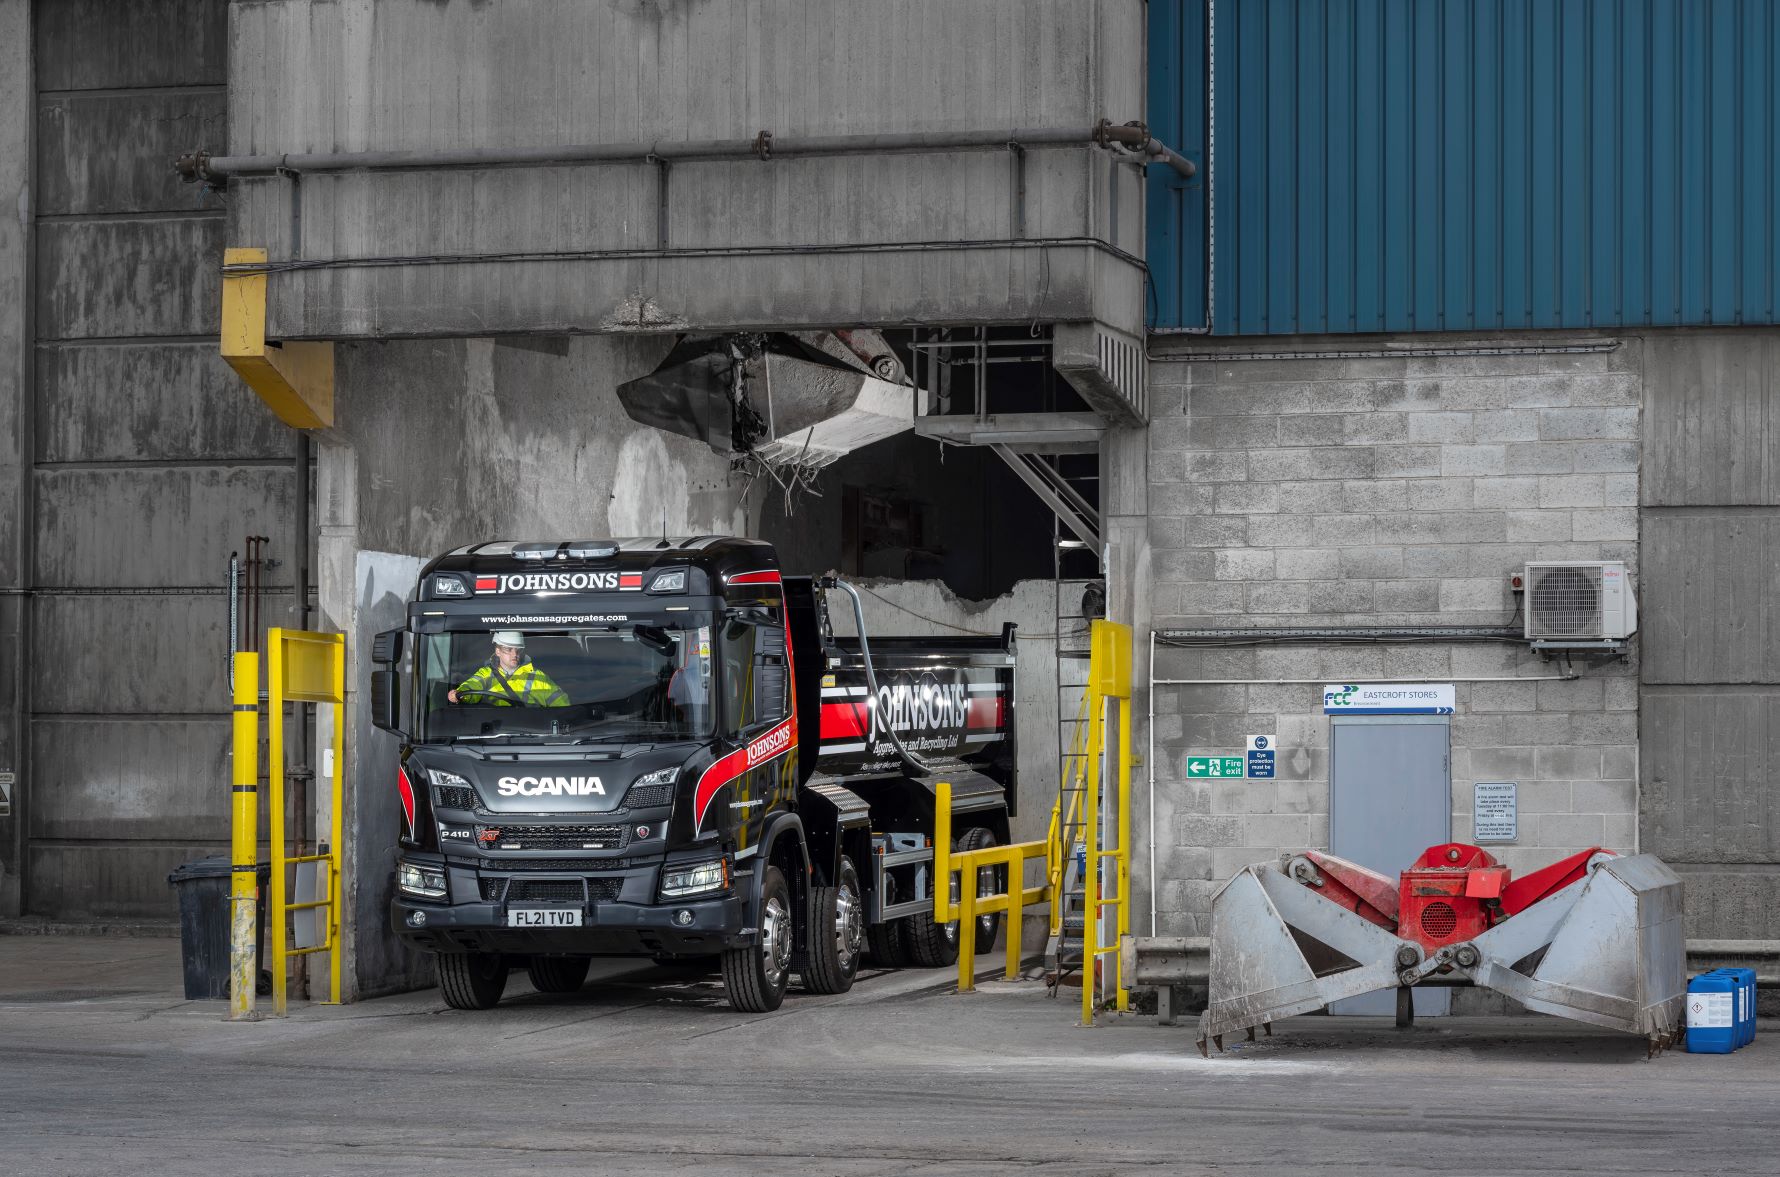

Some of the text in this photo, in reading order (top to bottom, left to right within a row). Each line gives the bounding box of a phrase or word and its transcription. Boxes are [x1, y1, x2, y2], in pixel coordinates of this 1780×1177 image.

[498, 573, 618, 594] JOHNSONS
[481, 614, 628, 624] www.johnsonsaggregates.com
[1363, 691, 1438, 699] EASTCROFT STORES
[867, 682, 966, 743] JOHNSONS
[746, 724, 791, 766] JOHNSONS
[907, 737, 920, 750] and
[948, 734, 959, 748] Ltd
[1225, 759, 1242, 767] Fire
[497, 776, 606, 796] SCANIA
[479, 830, 500, 841] XT
[516, 911, 574, 926] FL21 TVD
